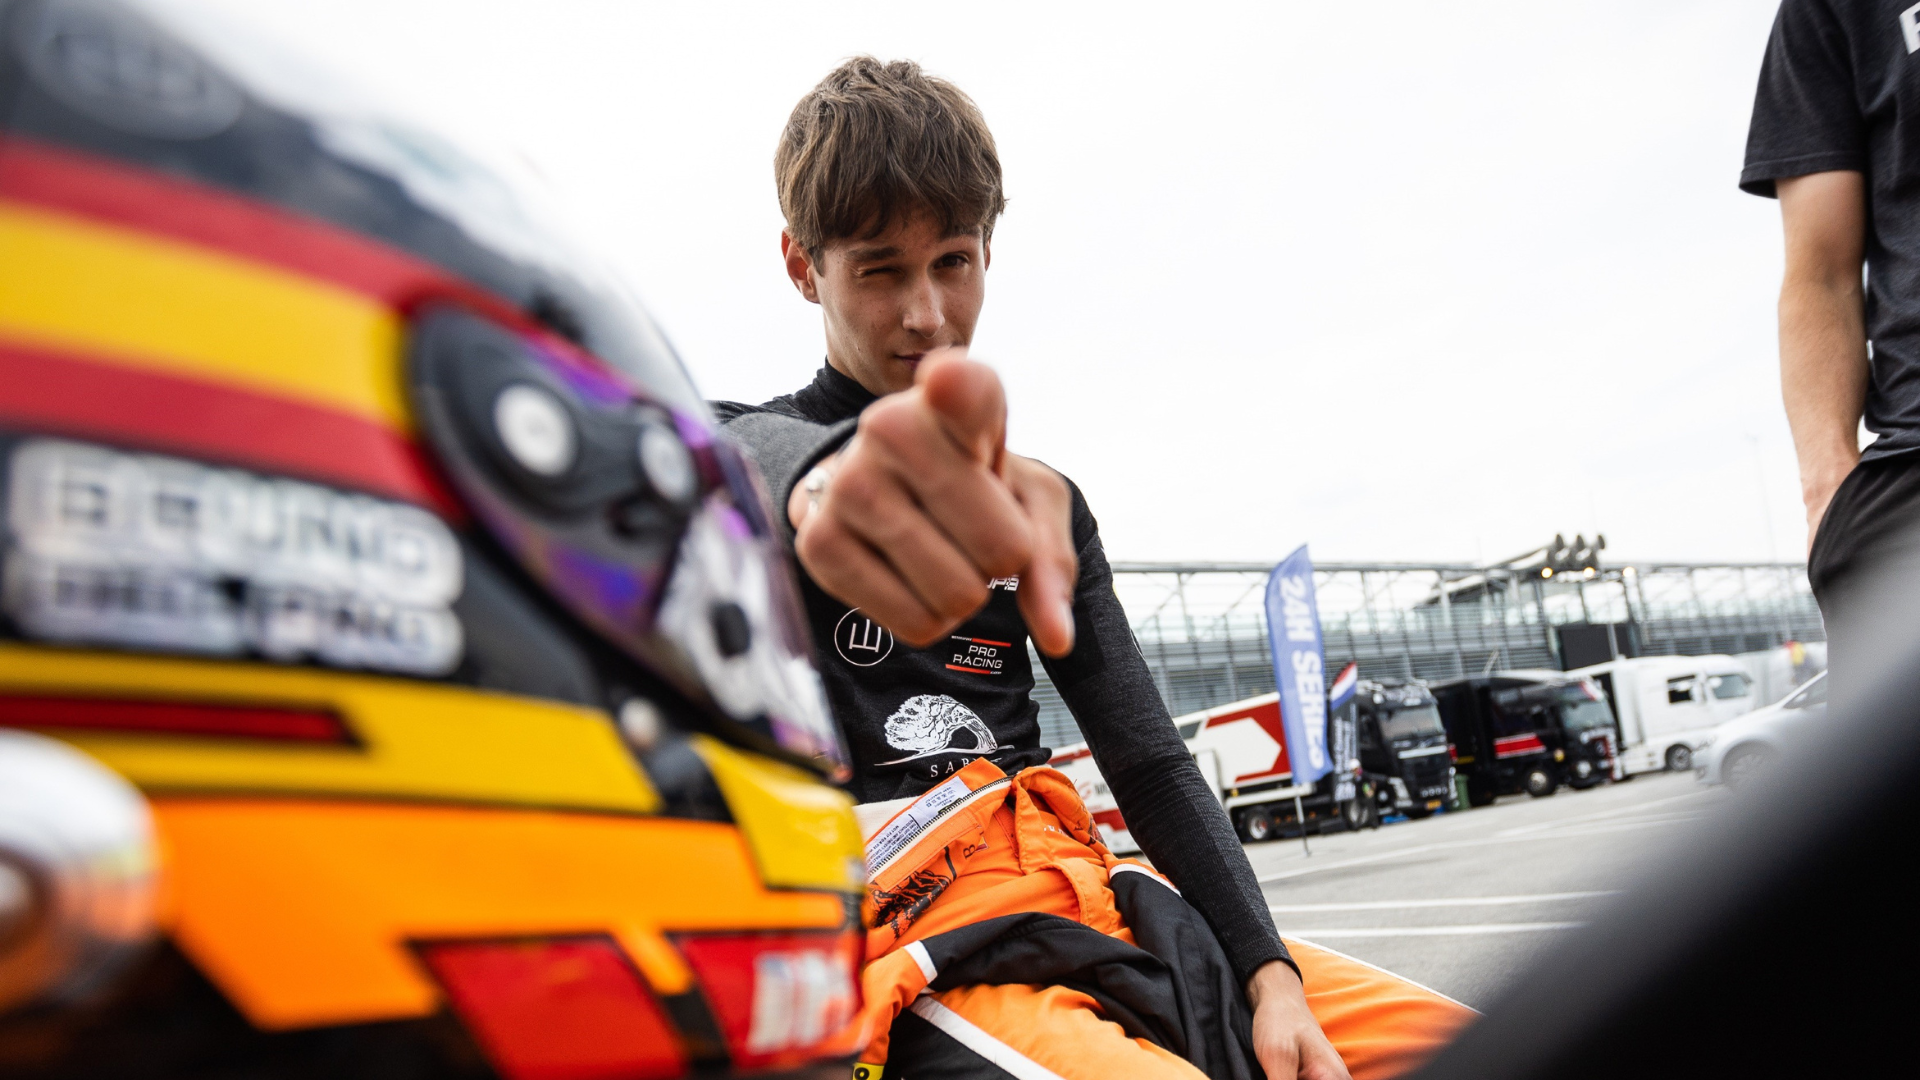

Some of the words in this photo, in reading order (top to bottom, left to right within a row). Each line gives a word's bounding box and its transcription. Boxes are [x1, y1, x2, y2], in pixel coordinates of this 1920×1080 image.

[1279, 574, 1315, 642] 24H
[967, 644, 997, 658] PRO
[952, 653, 1003, 669] RACING
